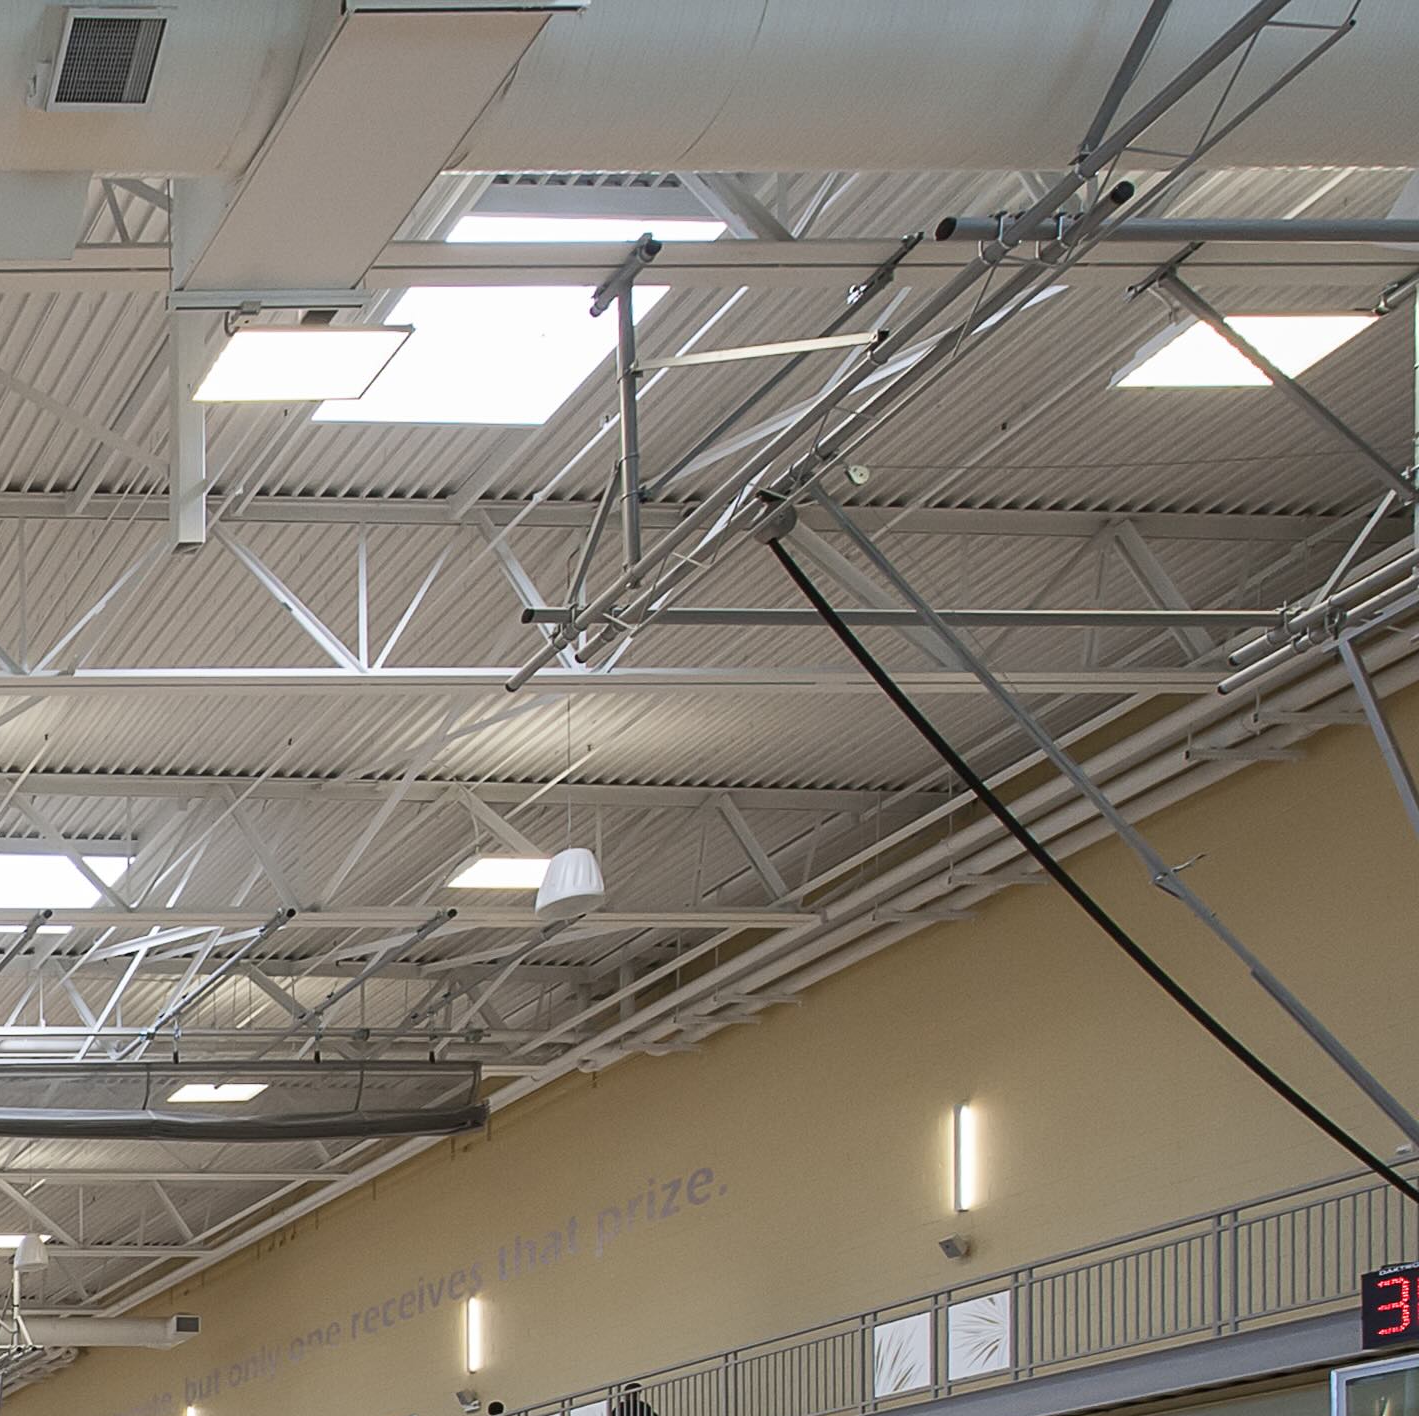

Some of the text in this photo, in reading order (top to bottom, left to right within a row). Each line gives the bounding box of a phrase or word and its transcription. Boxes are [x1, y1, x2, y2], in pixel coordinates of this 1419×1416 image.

[183, 1365, 223, 1406] but
[228, 1342, 283, 1389] only
[288, 1318, 343, 1362] one
[350, 1259, 485, 1342] receives
[496, 1213, 580, 1283] that
[594, 1164, 729, 1259] prize.
